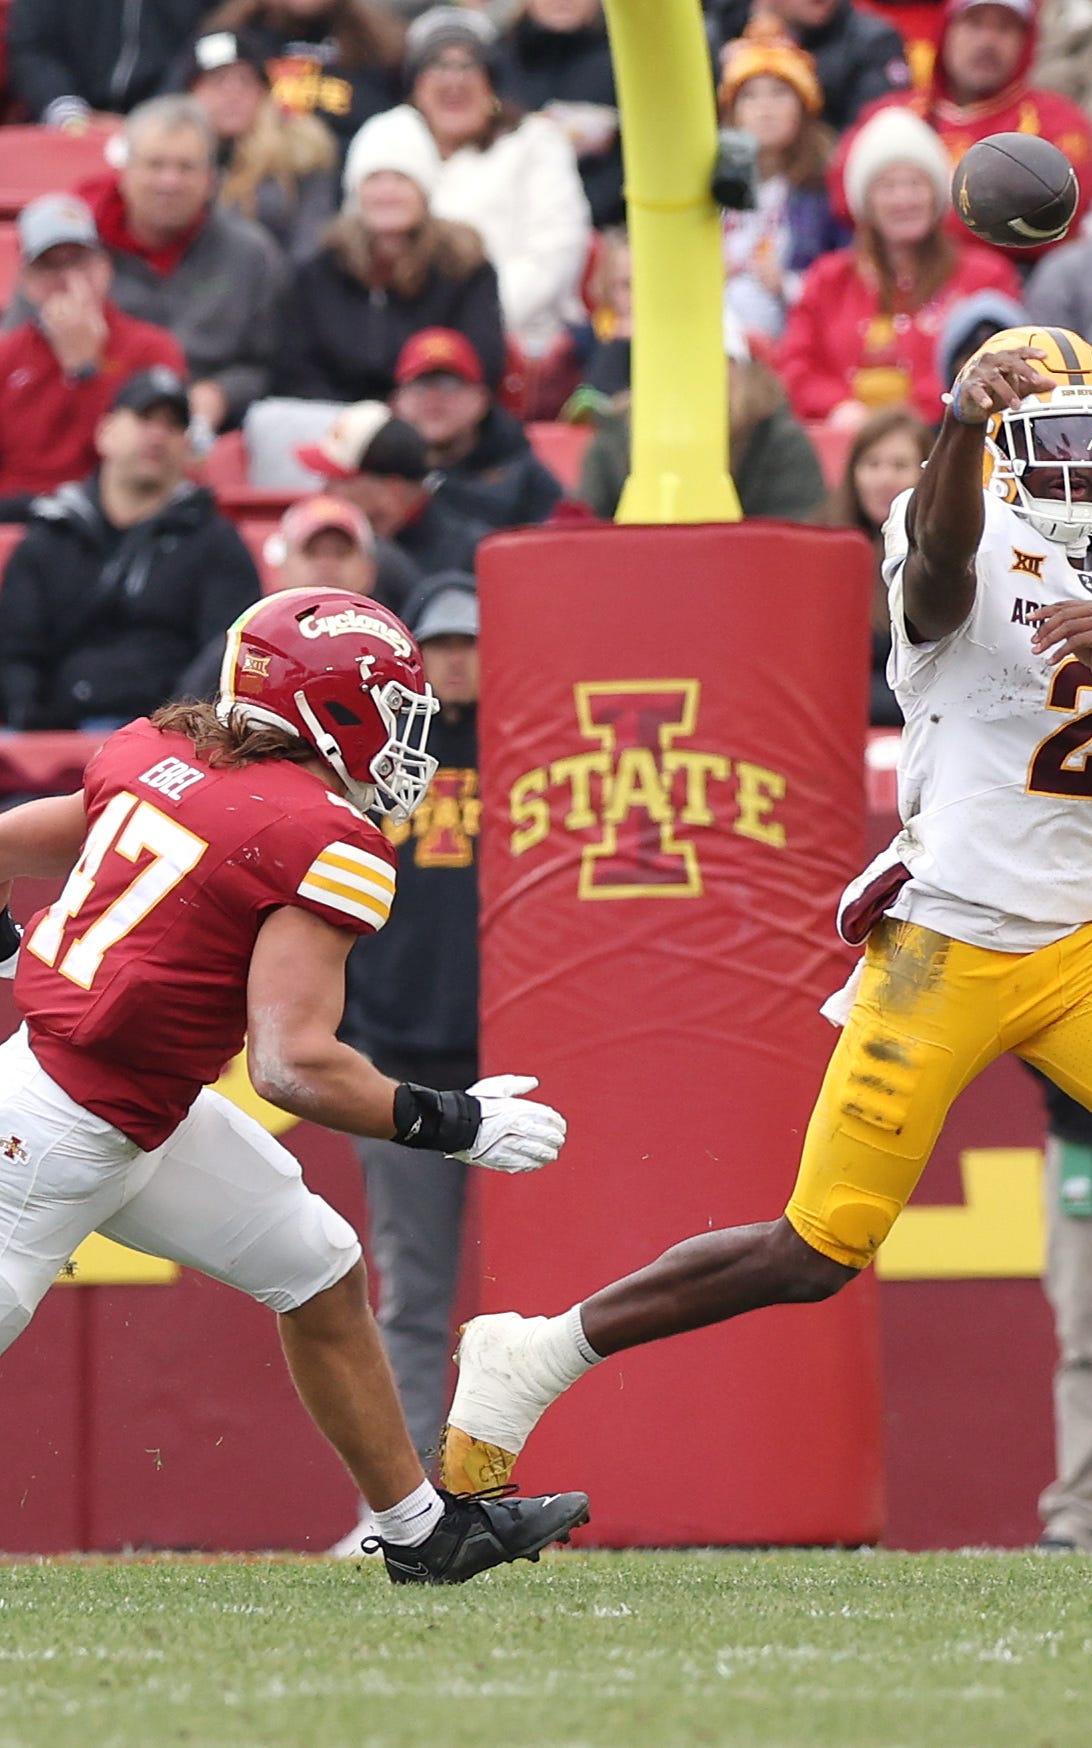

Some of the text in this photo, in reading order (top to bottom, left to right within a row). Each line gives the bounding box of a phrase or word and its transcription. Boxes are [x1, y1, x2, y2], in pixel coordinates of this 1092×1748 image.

[1010, 548, 1044, 579] XII
[138, 756, 206, 801] EBEL
[508, 747, 787, 858] STATE
[26, 790, 209, 991] 47
